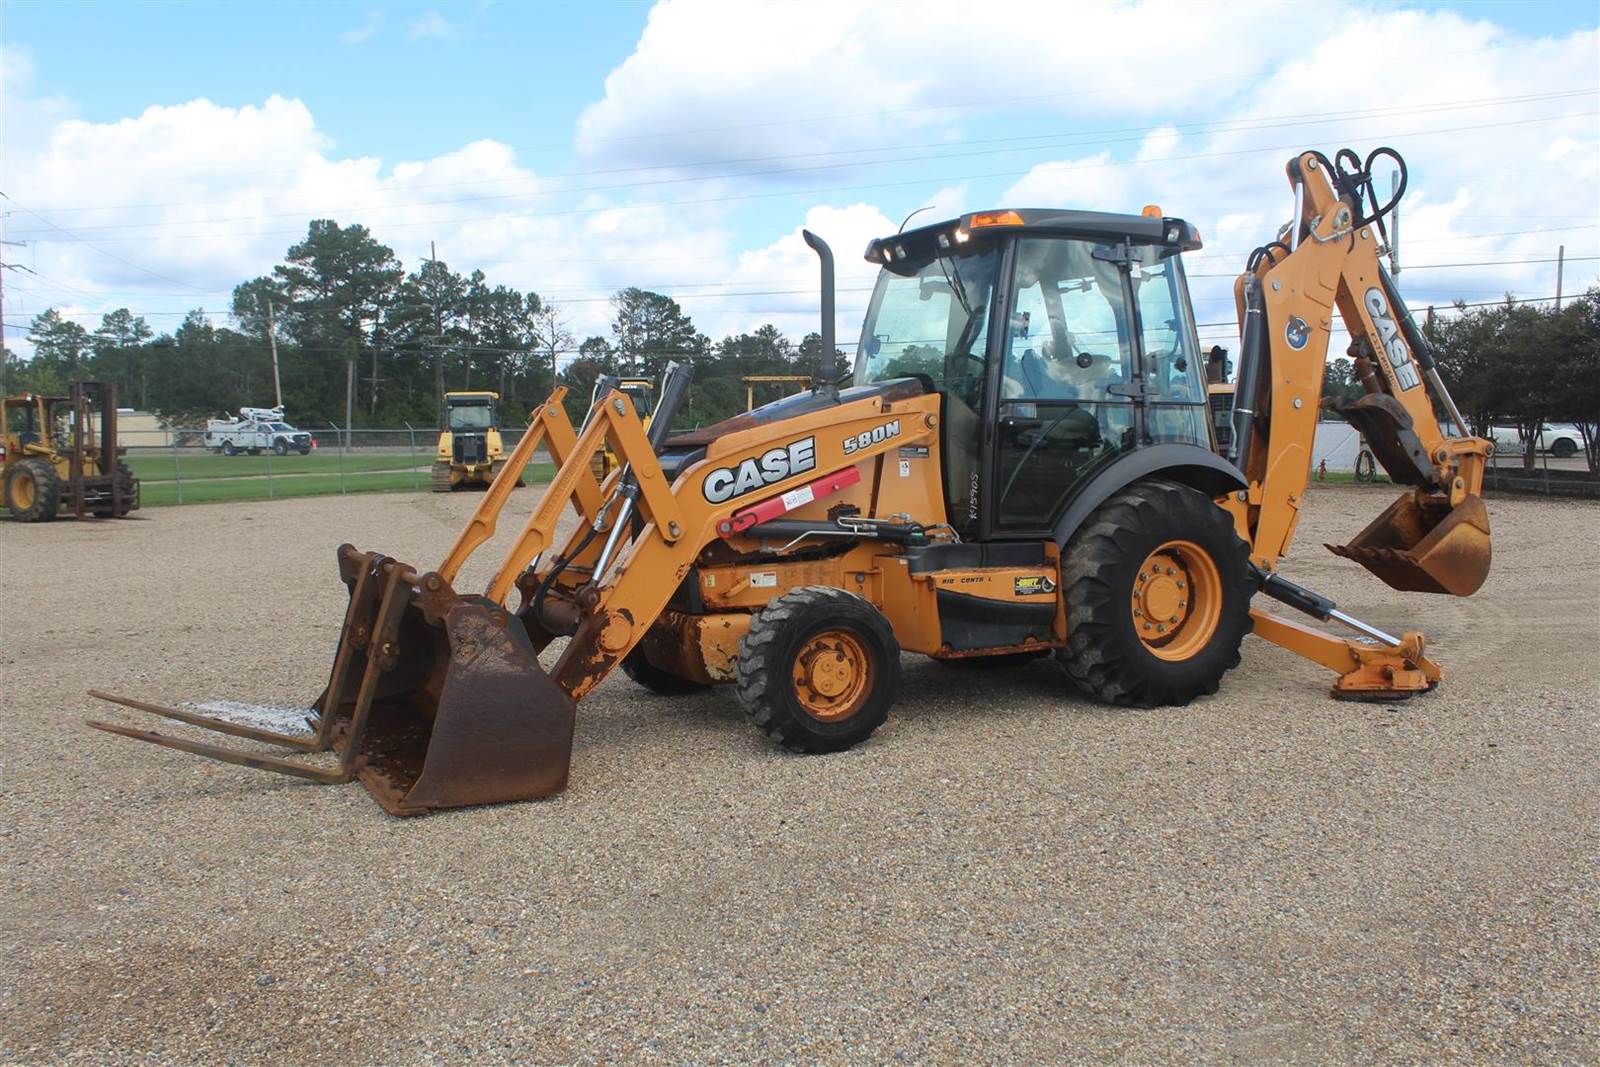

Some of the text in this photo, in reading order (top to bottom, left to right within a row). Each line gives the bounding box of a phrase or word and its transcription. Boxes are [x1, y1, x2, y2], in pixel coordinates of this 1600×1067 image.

[1364, 287, 1421, 392] CASE
[703, 436, 816, 504] CASE
[843, 419, 900, 455] 580N
